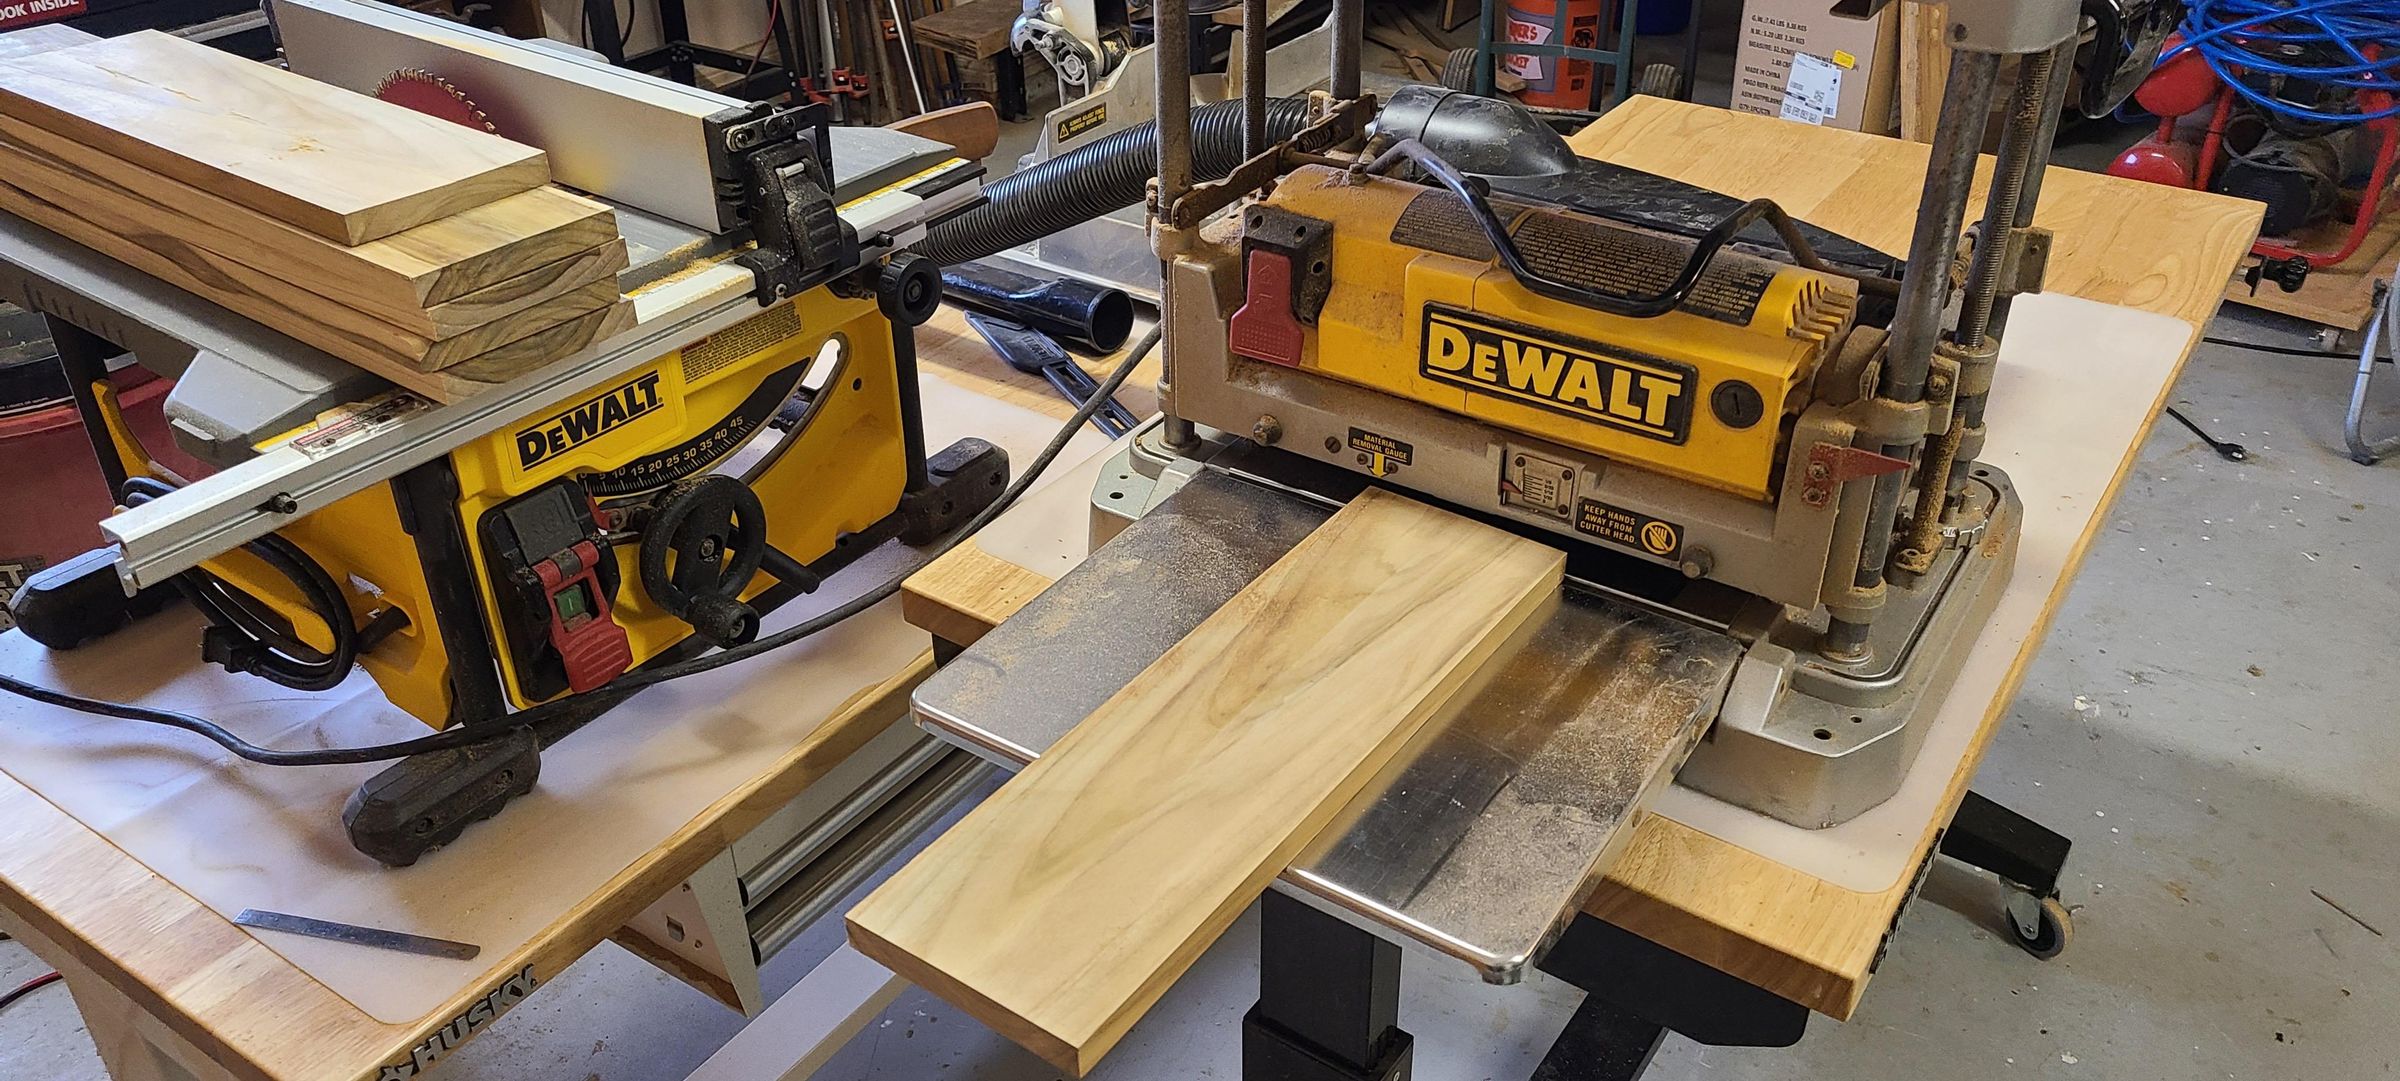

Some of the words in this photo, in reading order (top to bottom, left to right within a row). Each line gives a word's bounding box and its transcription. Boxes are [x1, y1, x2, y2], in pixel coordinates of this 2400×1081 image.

[612, 467, 626, 478] 10
[631, 464, 644, 476] 15
[648, 460, 662, 472] 20
[666, 454, 680, 467] 25
[683, 448, 696, 460] 30
[700, 438, 712, 450] 35
[714, 429, 728, 440] 40
[730, 416, 743, 428] 45
[1352, 438, 1382, 452] REMOVAL
[1385, 448, 1408, 460] GAUGE
[1364, 434, 1396, 449] MATERIAL
[1584, 504, 1606, 516] KEEP
[1608, 510, 1636, 526] HANDS
[1585, 514, 1606, 525] AWAY
[1608, 520, 1633, 534] FROM
[1580, 522, 1611, 536] CUTTER
[1613, 530, 1637, 545] HEAD.
[411, 963, 535, 1072] HUSKY
